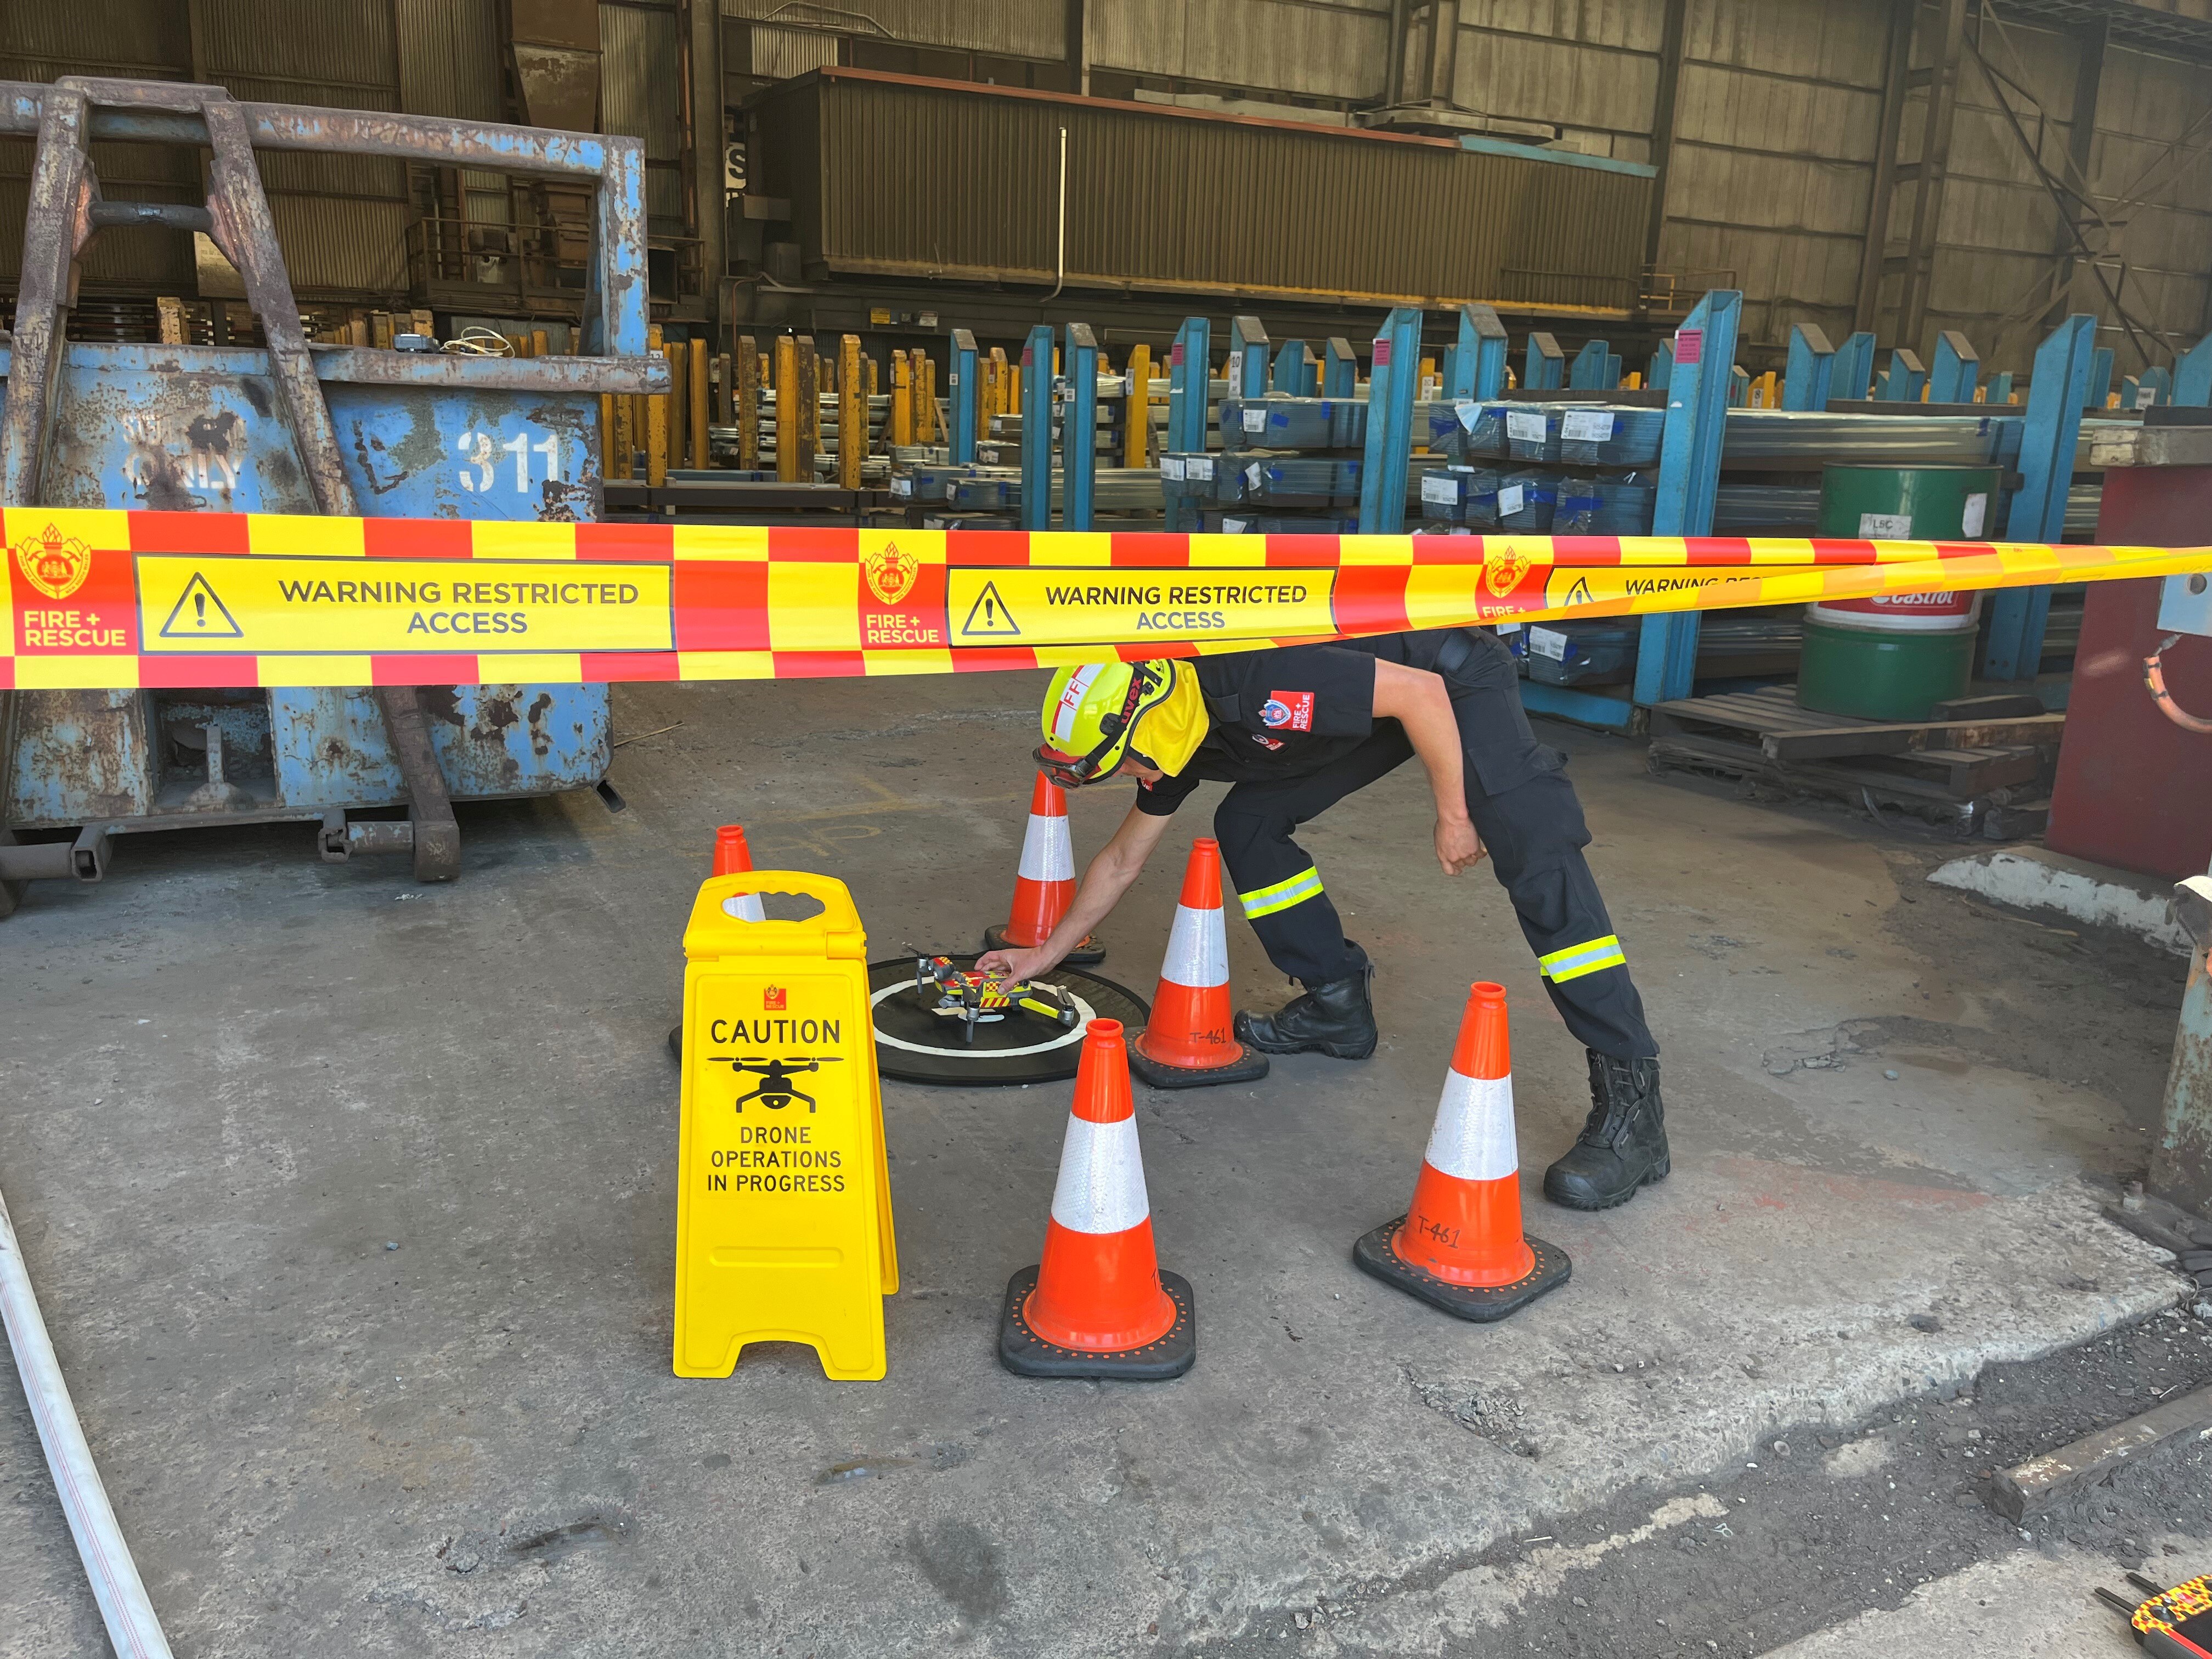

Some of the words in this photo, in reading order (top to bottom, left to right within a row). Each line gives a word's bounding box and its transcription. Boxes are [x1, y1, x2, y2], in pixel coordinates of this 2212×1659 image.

[458, 431, 558, 493] 311
[278, 579, 441, 603] WARNING
[452, 582, 639, 604] RESTRICTED
[1045, 585, 1160, 605] WARNING
[1169, 585, 1307, 605] RESTRICTED
[24, 610, 81, 628] FIRE
[1136, 611, 1226, 630] ACCESS
[1482, 605, 1514, 618] FIRE
[407, 611, 528, 634] ACCESS
[866, 614, 906, 629] FIRE
[25, 629, 127, 647] RESCUE
[867, 629, 939, 644] RESCUE
[1063, 680, 1080, 707] FF
[1121, 676, 1142, 724] uvex
[1292, 710, 1302, 729] FIRE
[1299, 694, 1311, 730] RESCUE
[710, 1019, 840, 1043] CAUTION
[1189, 1027, 1226, 1045] T-461
[740, 1126, 811, 1144] DRONE
[711, 1150, 842, 1168] OPERATIONS
[707, 1174, 727, 1191] IN
[736, 1175, 845, 1192] PROGRESS
[1418, 1215, 1460, 1249] T-461
